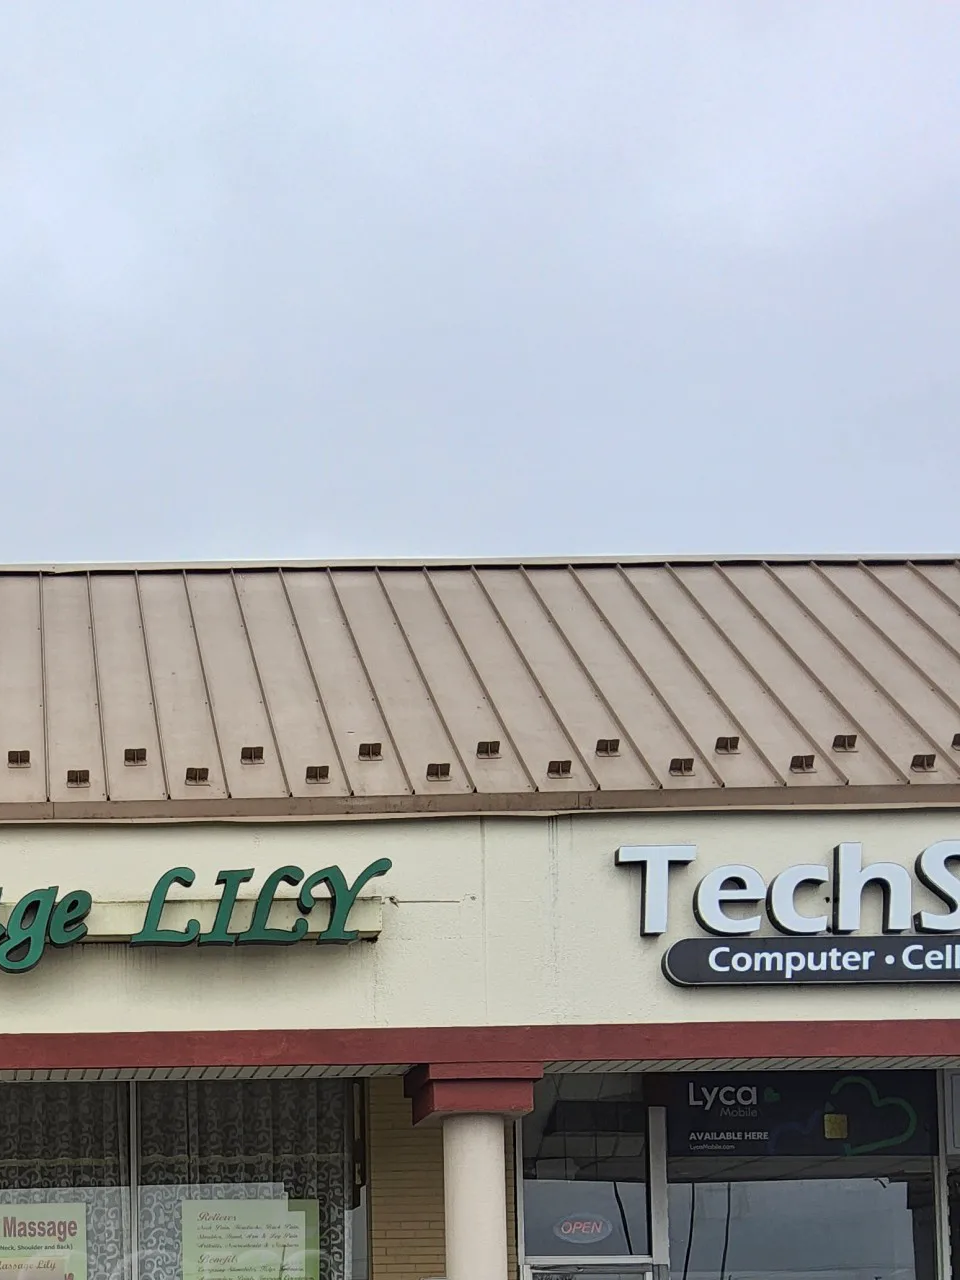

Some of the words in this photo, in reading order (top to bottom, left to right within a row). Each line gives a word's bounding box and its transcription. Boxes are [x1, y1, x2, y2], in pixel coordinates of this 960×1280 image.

[615, 841, 960, 937] TechS
[129, 858, 393, 948] LILY
[708, 946, 875, 978] Computer
[902, 944, 960, 971] Cell
[688, 1082, 758, 1111] Lyca
[720, 1107, 758, 1117] Mobile
[689, 1131, 743, 1141] AVAILABLE
[744, 1131, 769, 1140] HERE
[3, 1216, 78, 1242] Massage
[561, 1220, 604, 1235] OPEN
[36, 1259, 57, 1271] Lily
